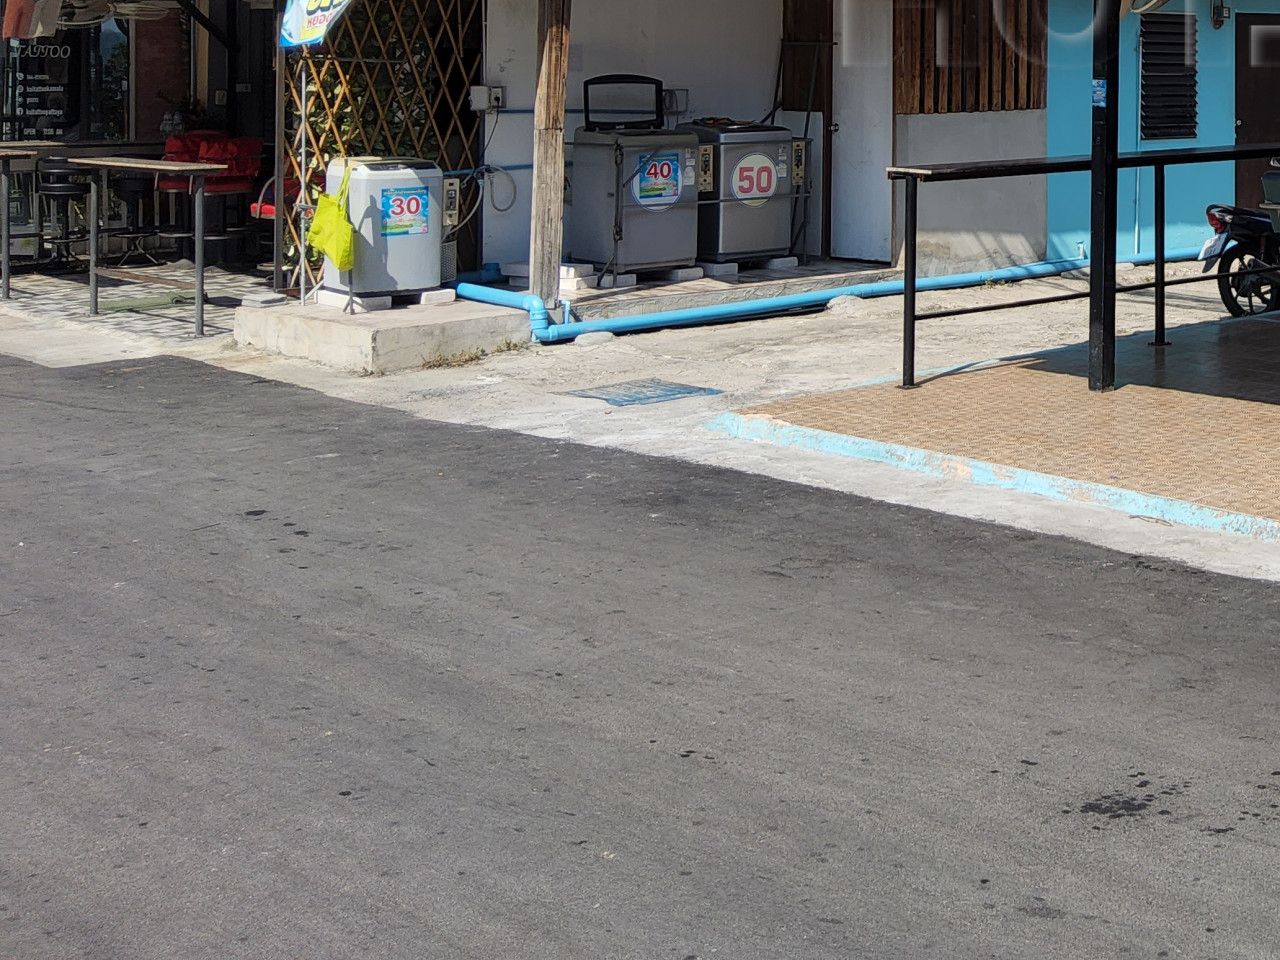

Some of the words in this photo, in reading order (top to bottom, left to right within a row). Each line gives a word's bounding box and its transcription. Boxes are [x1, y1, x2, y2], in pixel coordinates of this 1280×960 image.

[17, 44, 71, 58] TATTOO
[645, 161, 672, 180] 40
[738, 166, 772, 194] 50
[390, 196, 421, 216] 30
